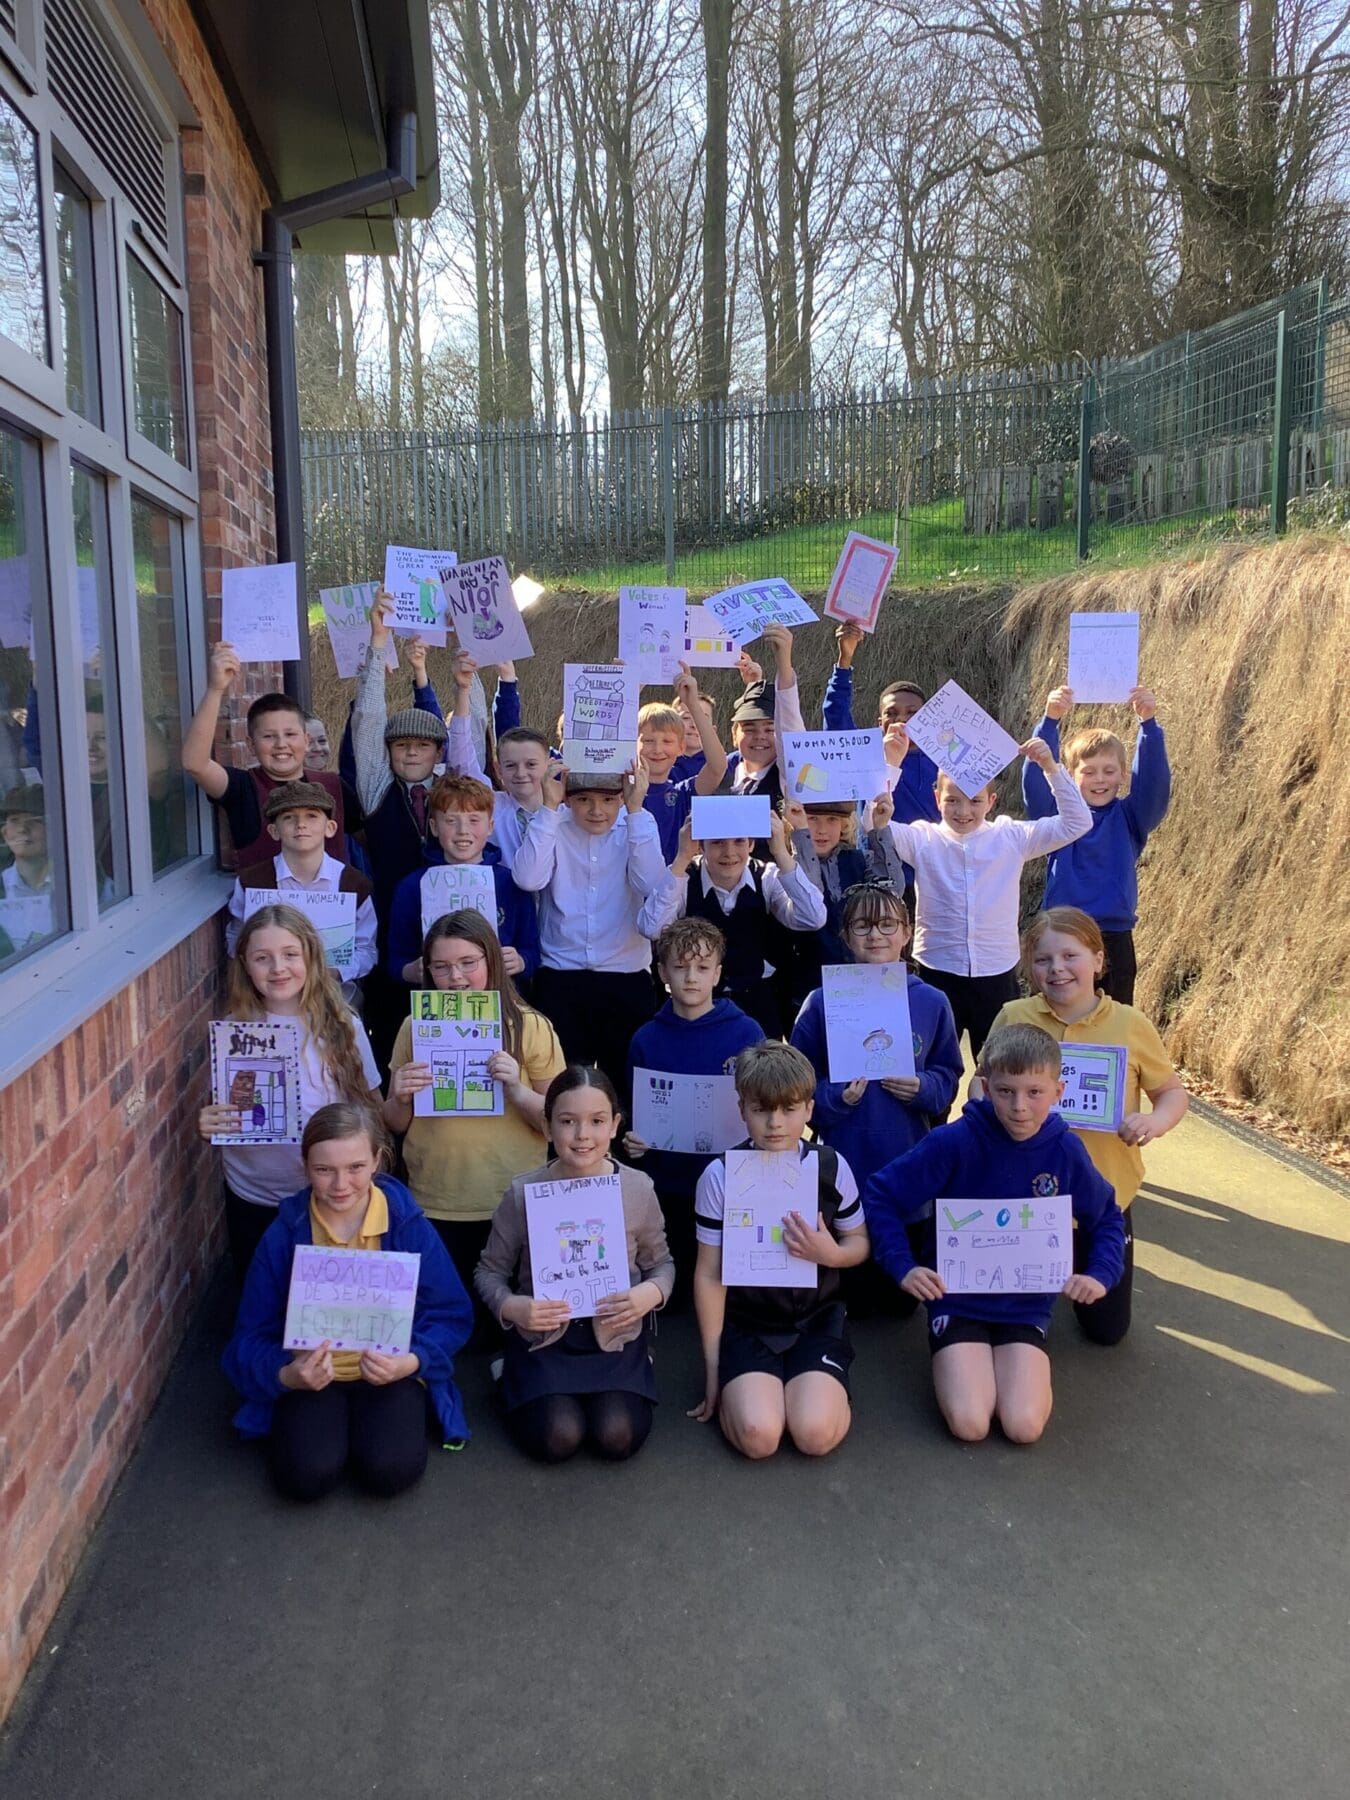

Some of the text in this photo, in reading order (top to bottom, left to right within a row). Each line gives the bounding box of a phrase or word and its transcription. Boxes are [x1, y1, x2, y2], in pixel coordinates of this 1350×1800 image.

[474, 558, 502, 573] WIN
[459, 571, 498, 591] US AND
[394, 592, 415, 600] LET
[449, 580, 499, 616] JOIN
[628, 590, 658, 601] Votes
[722, 585, 796, 610] VOTES
[751, 600, 782, 614] FOR
[580, 708, 613, 720] WORDS
[792, 738, 836, 749] WOMAN
[918, 735, 943, 755] NOT
[820, 752, 852, 761] VOTE
[428, 868, 488, 889] VOTES
[249, 890, 282, 905] VOTES
[450, 893, 486, 911] FOR
[421, 992, 489, 1020] LET
[418, 1024, 500, 1038] US VOTE
[435, 1076, 456, 1089] TO
[532, 1183, 556, 1198] LET
[301, 1256, 405, 1289] WOMEN
[565, 1269, 575, 1279] to
[300, 1305, 407, 1343] EQUALITY
